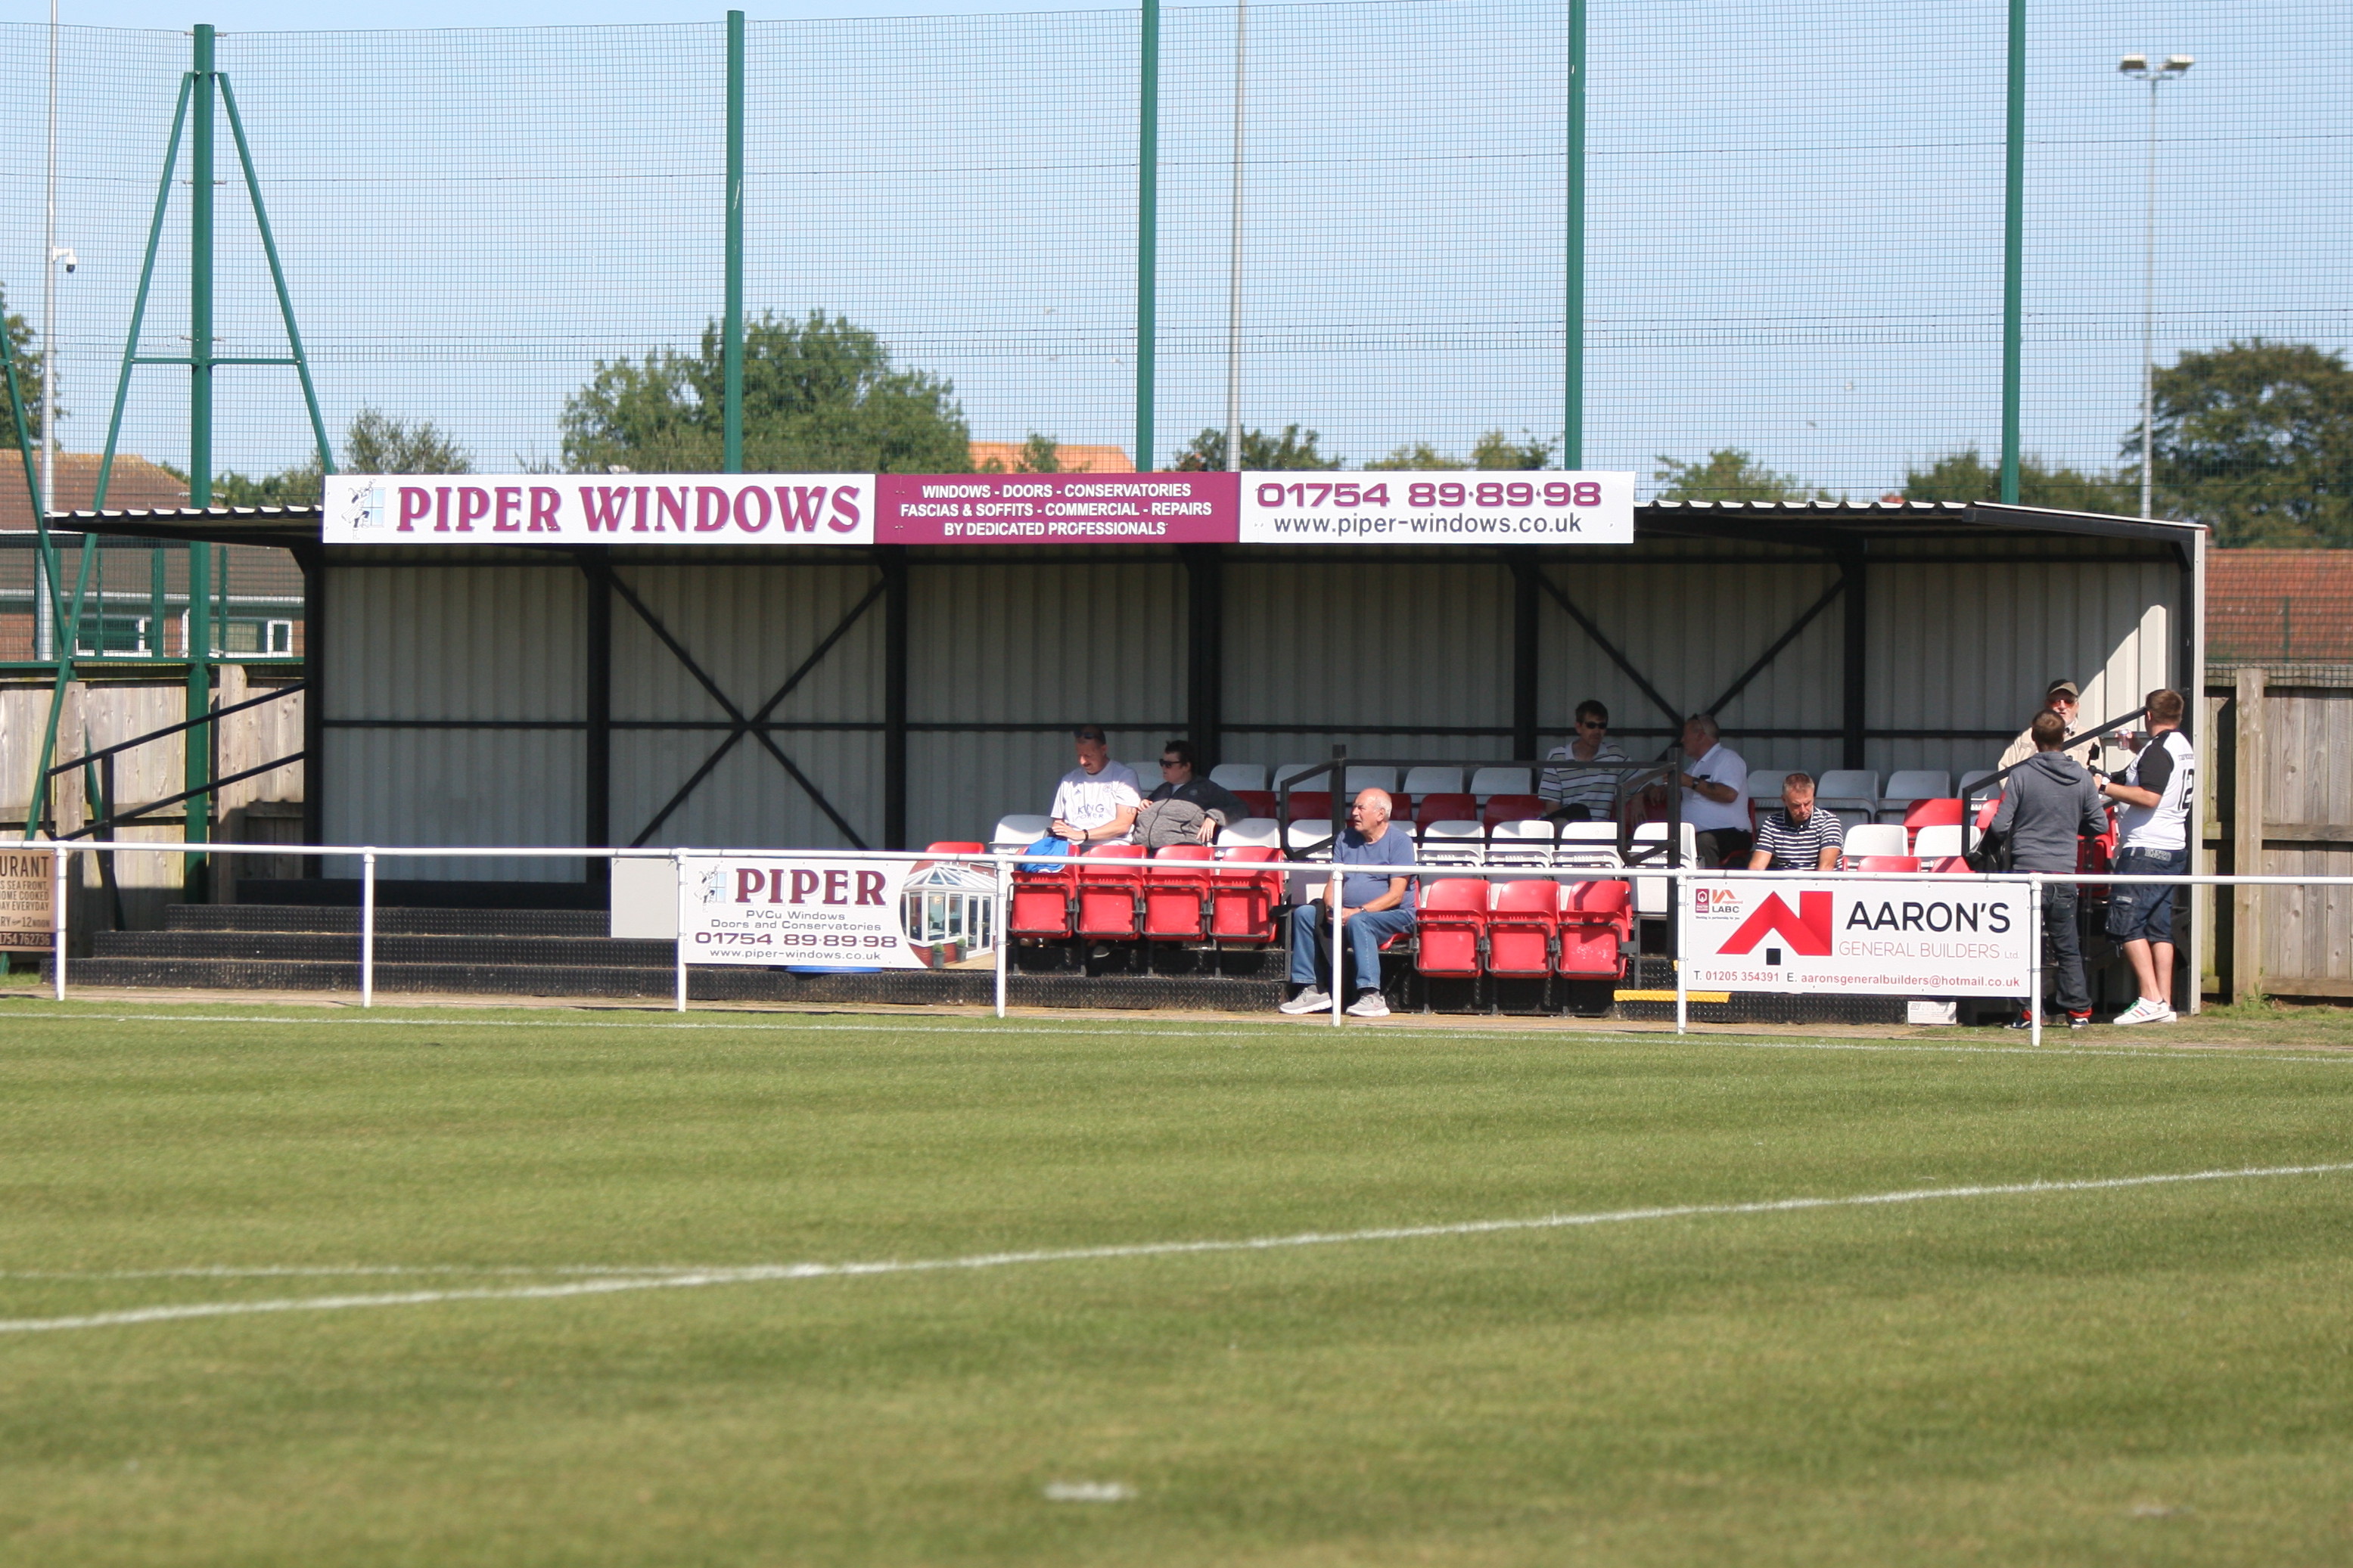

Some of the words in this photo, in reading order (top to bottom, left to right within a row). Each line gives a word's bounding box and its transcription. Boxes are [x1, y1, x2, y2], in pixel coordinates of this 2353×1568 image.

[922, 485, 991, 498] WINDOWS
[1002, 484, 1053, 498] DOORS
[1065, 483, 1192, 498] CONSERVATORIES
[1257, 483, 1391, 508] 01754
[396, 486, 562, 532] PIPER
[578, 485, 861, 533] WINDOWS
[900, 504, 959, 517] FASCIAS
[962, 503, 973, 517] &
[976, 503, 1034, 517] SOFFITS
[1045, 502, 1140, 517] COMMERCIAL
[1152, 501, 1213, 516] REPAIRS
[944, 522, 963, 536] BY
[966, 522, 1045, 536] DEDICATED
[1048, 522, 1166, 536] PROFESSIONALS
[1273, 512, 1582, 537] www.piper-windows.co.uk
[7, 880, 21, 890] SEA
[735, 868, 887, 906] PIPER
[0, 890, 17, 900] OME
[19, 890, 49, 901] COOKED
[0, 901, 10, 911] AY
[12, 901, 49, 911] EVERYDAY
[1711, 905, 1740, 914] LABC
[746, 910, 782, 919] PVCu
[787, 911, 845, 921] Windows
[1845, 901, 2011, 934] AARON'S
[711, 919, 749, 928] Doors
[754, 921, 777, 929] and
[782, 921, 881, 931] Conservatories
[695, 932, 773, 945] 01754
[710, 949, 881, 960] www.piper-windows.co.uk
[1839, 940, 1916, 957] GENERAL
[1920, 942, 2000, 959] BUILDERS
[1694, 970, 1702, 980] T.
[1705, 970, 1738, 981] 01205
[1741, 971, 1779, 982] 354391
[1787, 972, 1798, 982] E.
[1801, 973, 2020, 988] aaronsgeneralbuilders@hotmail.co.uk
